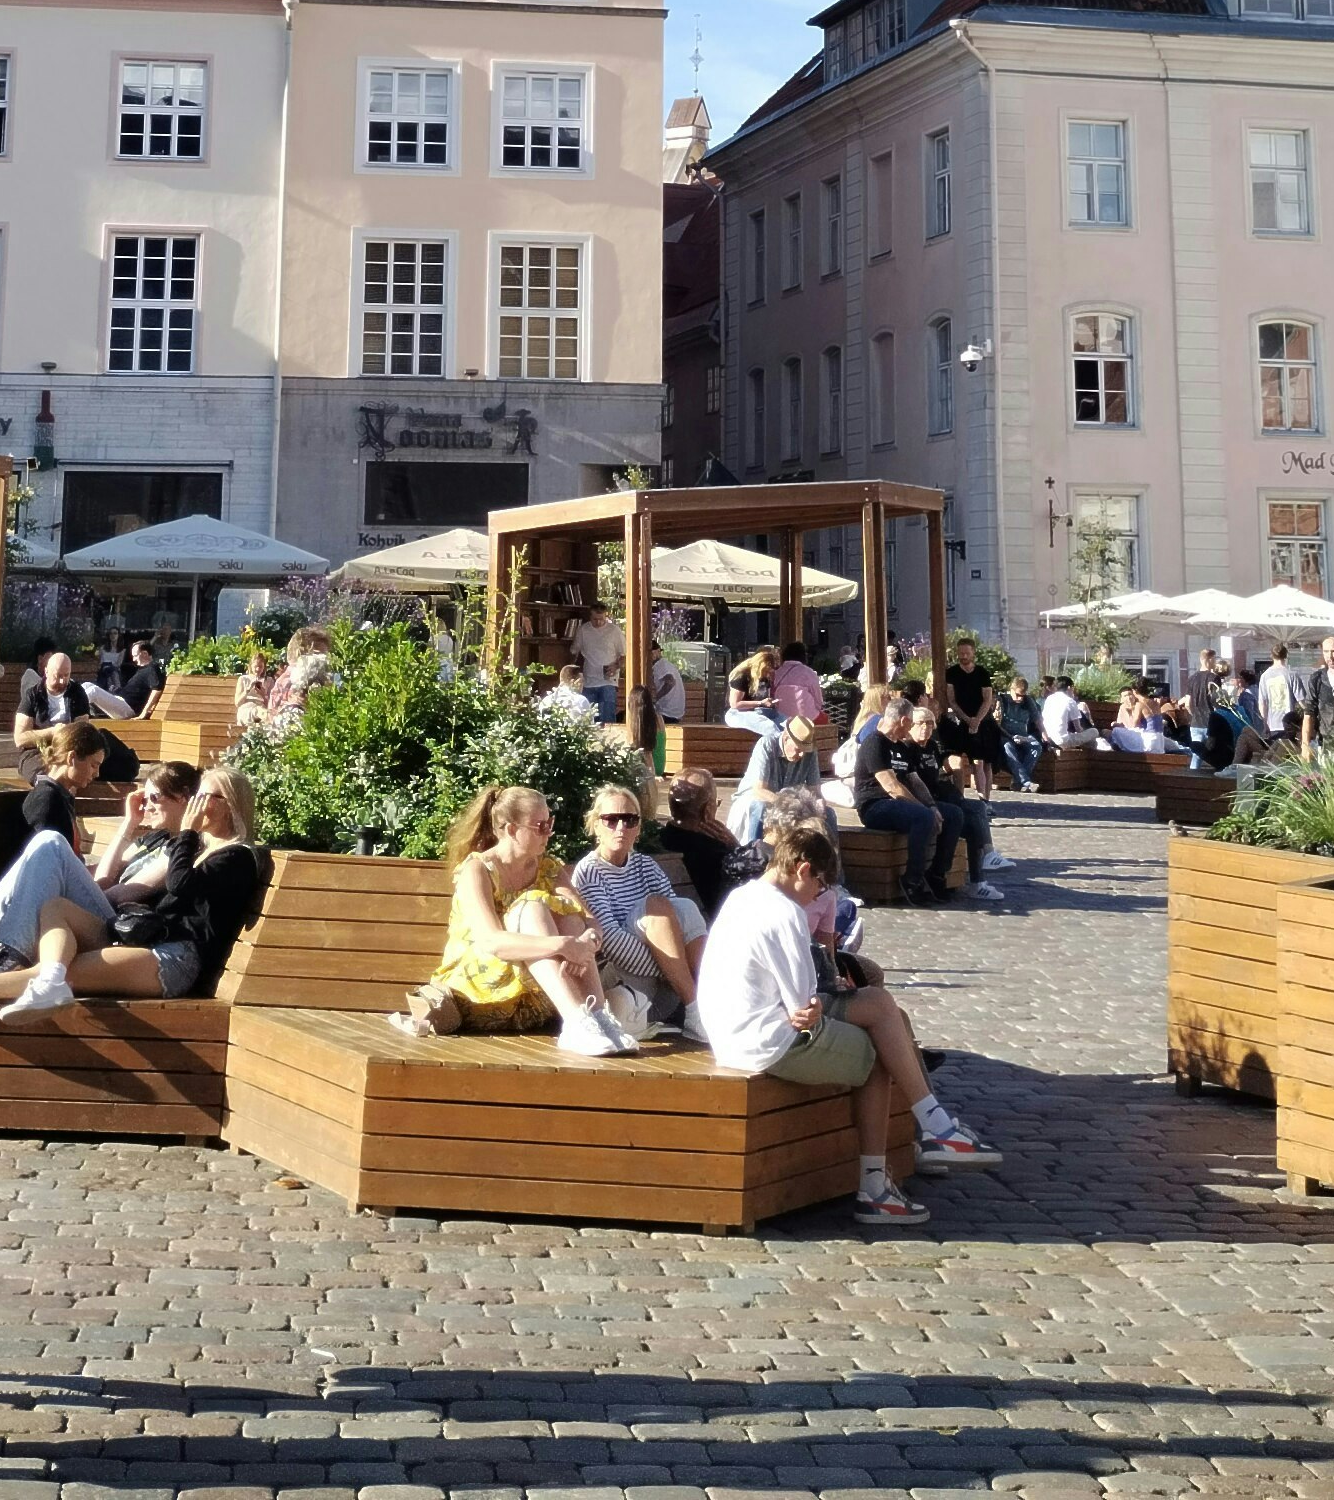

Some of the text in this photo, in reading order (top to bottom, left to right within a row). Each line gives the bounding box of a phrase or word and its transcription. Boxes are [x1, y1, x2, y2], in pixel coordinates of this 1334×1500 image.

[1282, 451, 1327, 475] Mad
[358, 533, 406, 548] Kohvik
[15, 554, 35, 565] aku
[422, 551, 489, 561] A.LeC
[89, 556, 308, 572] saku saku saku saku
[713, 584, 753, 595] A.LeCoq
